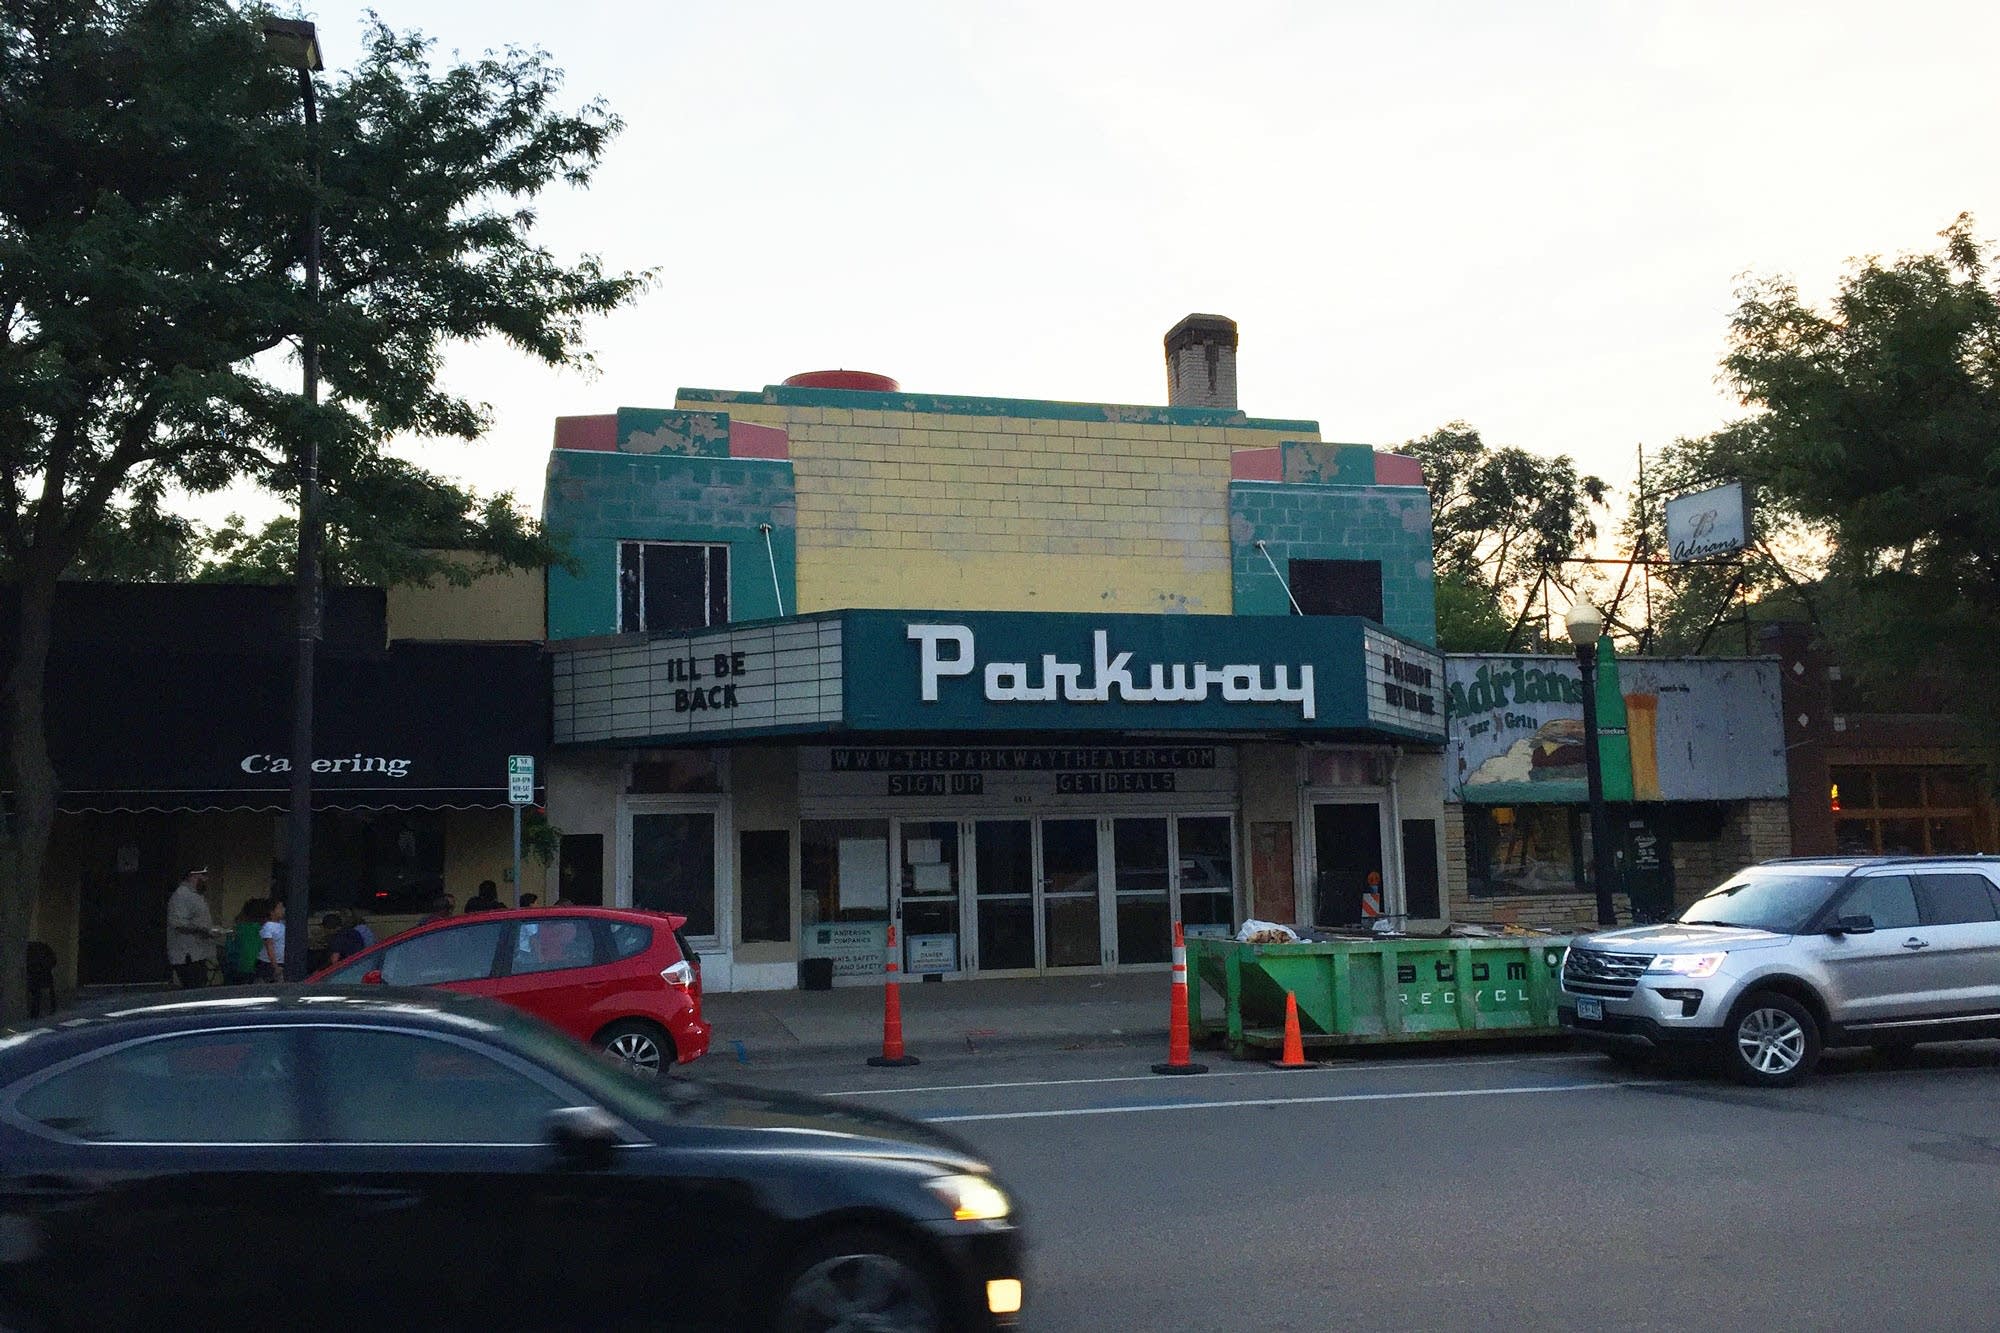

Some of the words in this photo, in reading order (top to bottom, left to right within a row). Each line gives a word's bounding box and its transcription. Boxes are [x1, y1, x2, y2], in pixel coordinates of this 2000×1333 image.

[1673, 537, 1739, 560] Adrians
[667, 656, 702, 683] ILL
[714, 651, 746, 678] BE
[907, 623, 1316, 719] Parkway
[674, 683, 740, 713] BACK
[1446, 658, 1584, 718] Adrians
[240, 753, 412, 778] Caering
[510, 759, 516, 771] 2
[891, 774, 944, 794] SIGN
[952, 773, 983, 793] UP
[1059, 773, 1100, 792] GET
[1106, 772, 1175, 791] DEALS
